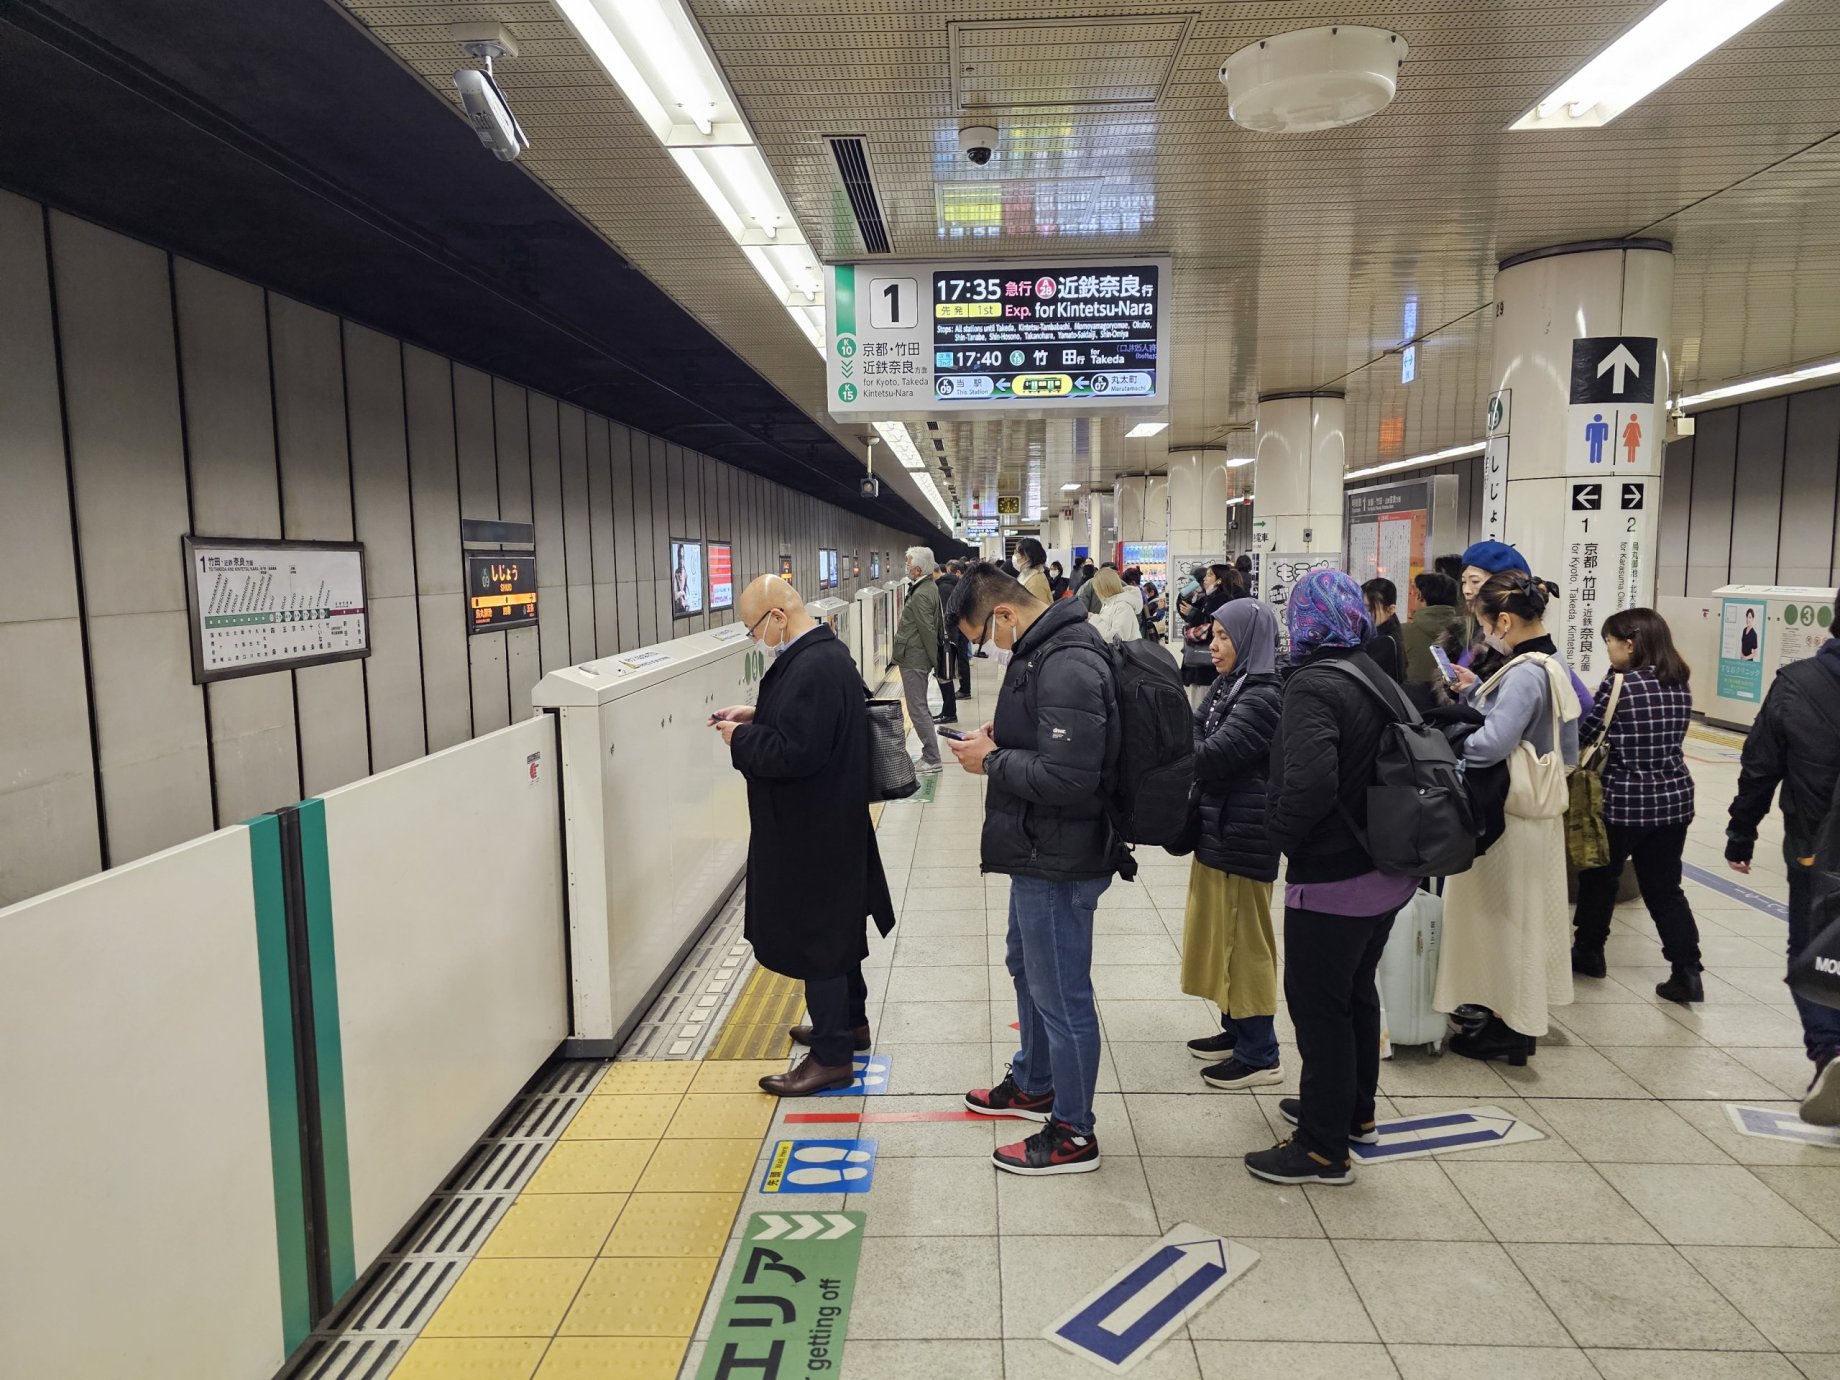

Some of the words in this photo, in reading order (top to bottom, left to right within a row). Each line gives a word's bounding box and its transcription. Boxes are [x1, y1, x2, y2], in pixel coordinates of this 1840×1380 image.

[938, 279, 1001, 301] 17:35
[1005, 281, 1032, 297] 急行
[884, 284, 899, 323] 1
[977, 304, 994, 315] 1st
[1035, 302, 1055, 318] for
[1057, 300, 1153, 318] Kintetsu-Nara
[1005, 304, 1032, 320] Exp.
[937, 325, 954, 334] Stops:
[841, 346, 853, 356] 10
[862, 342, 920, 357] 京都・竹田
[957, 351, 1002, 367] 17:40
[1091, 354, 1125, 365] Takeda
[863, 378, 873, 387] for
[876, 379, 900, 390] Kyoto,
[902, 377, 929, 386] Takeda
[940, 386, 953, 394] 09
[1094, 382, 1107, 391] 07
[842, 391, 854, 400] 15
[863, 389, 914, 398] Kintetsu-Nara
[1581, 517, 1589, 533] 1
[1626, 516, 1637, 532] 2
[1571, 543, 1581, 554] for
[1620, 541, 1628, 551] for
[200, 555, 206, 574] 1
[1568, 557, 1580, 585] Kyoto,
[491, 564, 518, 582] しじょう
[1567, 587, 1579, 622] Takeda,
[1566, 625, 1577, 660] Kintetsu
[819, 1278, 841, 1301] off
[807, 1306, 842, 1372] getting
